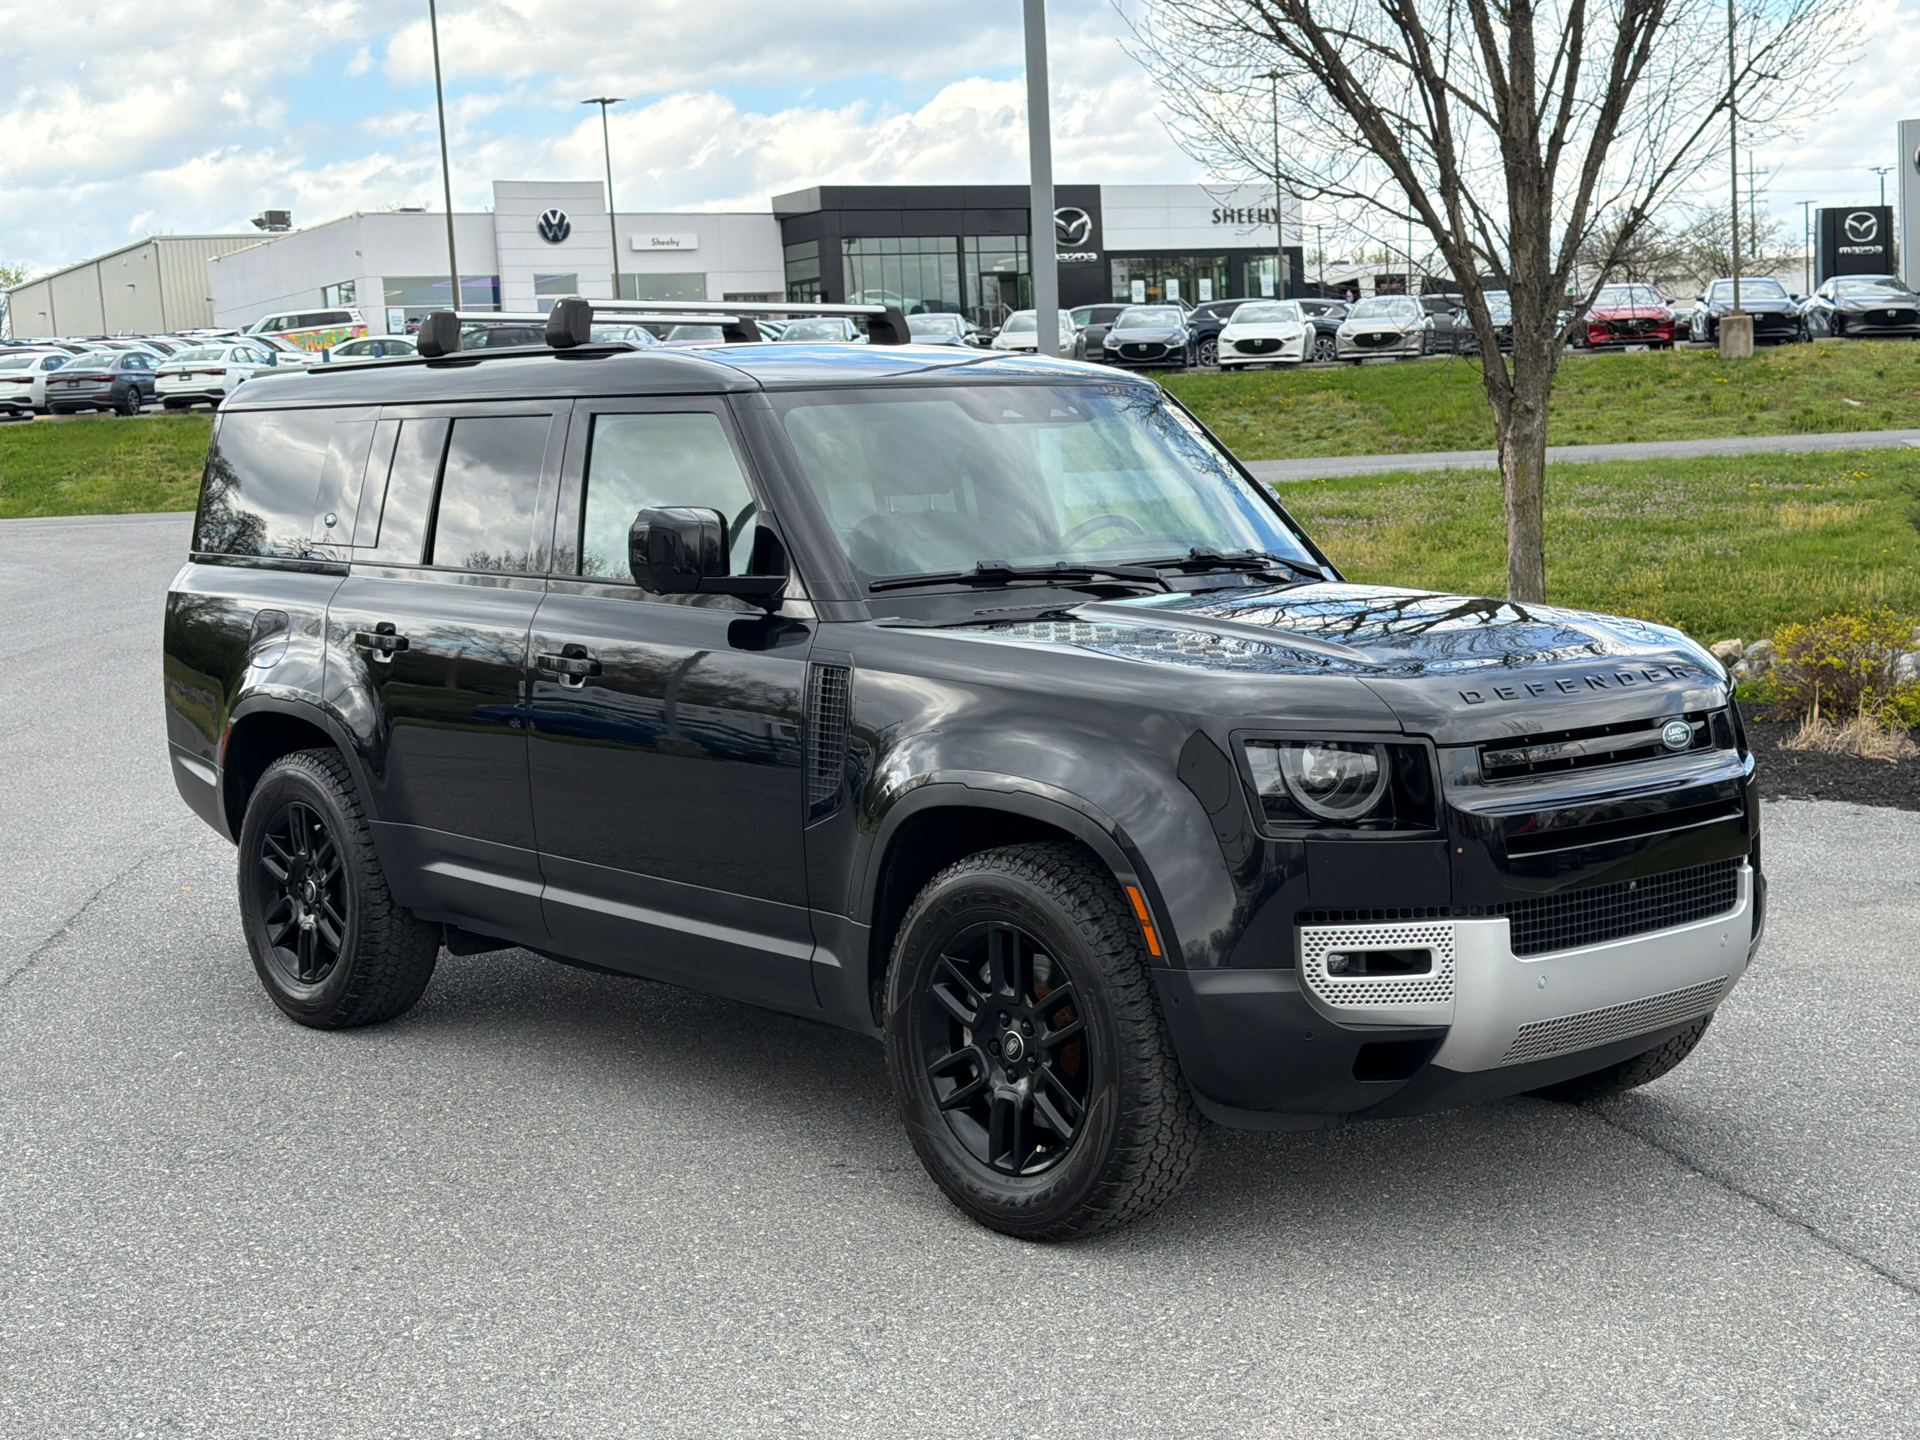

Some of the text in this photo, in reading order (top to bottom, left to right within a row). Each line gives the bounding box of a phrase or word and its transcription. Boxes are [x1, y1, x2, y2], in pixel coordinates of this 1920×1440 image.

[651, 237, 680, 247] Sheehy
[1055, 252, 1098, 262] azda
[1458, 664, 1692, 704] DEFENDER
